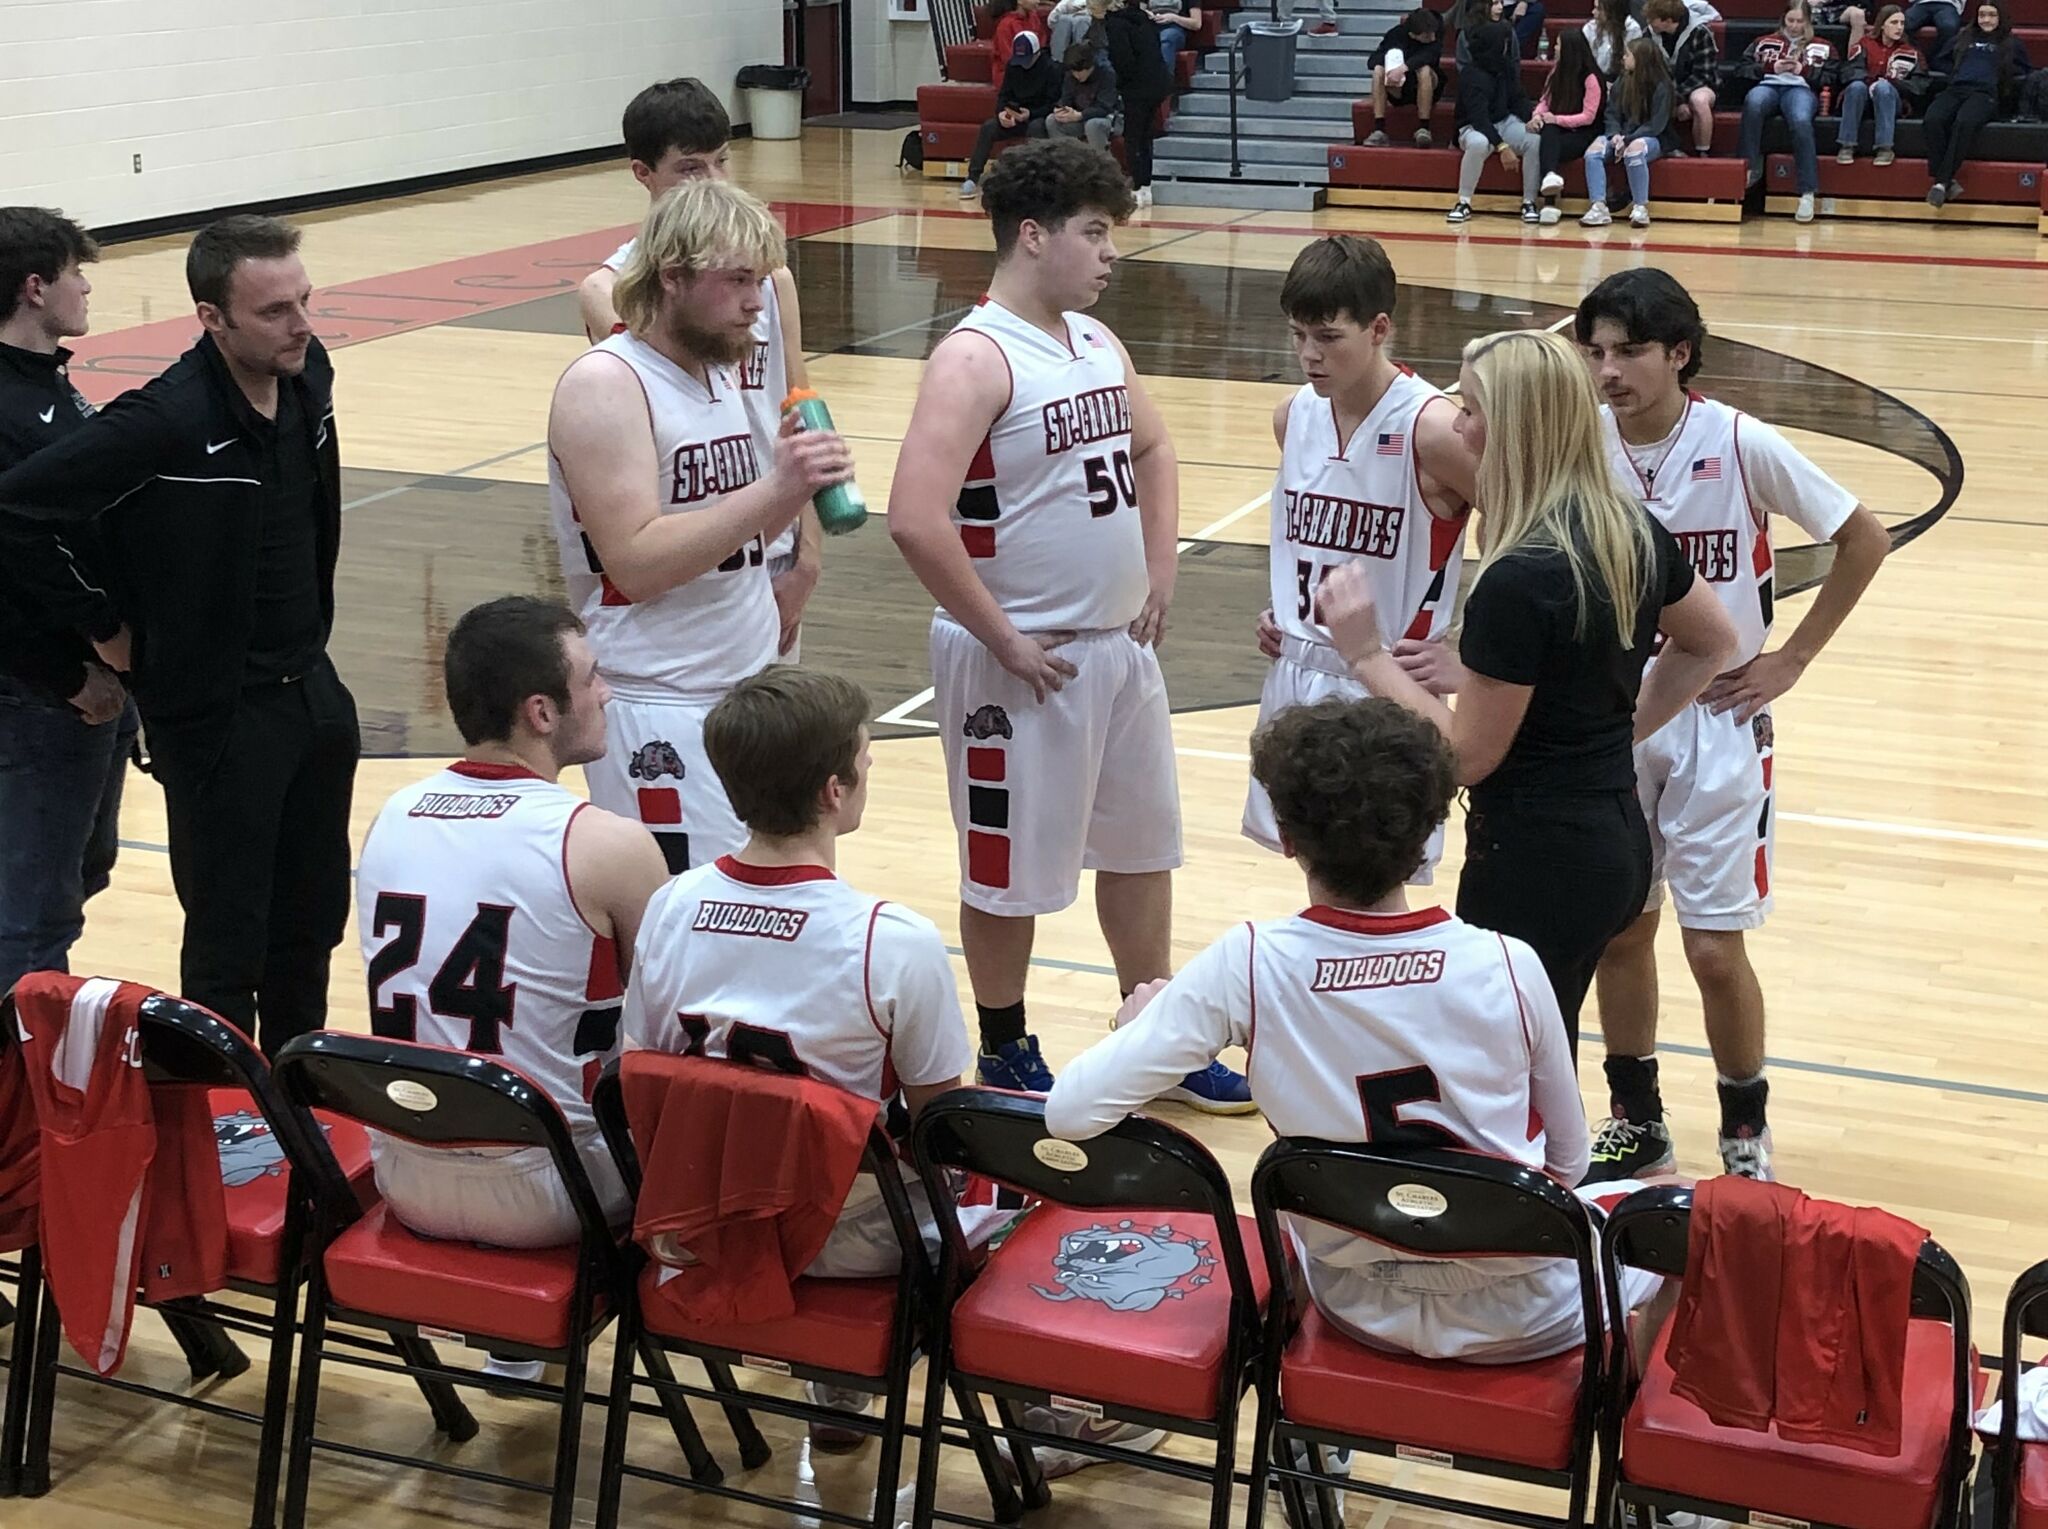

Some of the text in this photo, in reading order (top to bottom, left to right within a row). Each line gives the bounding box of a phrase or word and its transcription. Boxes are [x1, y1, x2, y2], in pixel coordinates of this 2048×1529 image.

[1084, 449, 1137, 518] 50
[1672, 529, 1738, 583] LES
[408, 793, 521, 819] BULLDOGS
[692, 900, 809, 942] BULLDOGS
[368, 891, 517, 1055] 24
[1310, 950, 1446, 992] BULLDOGS
